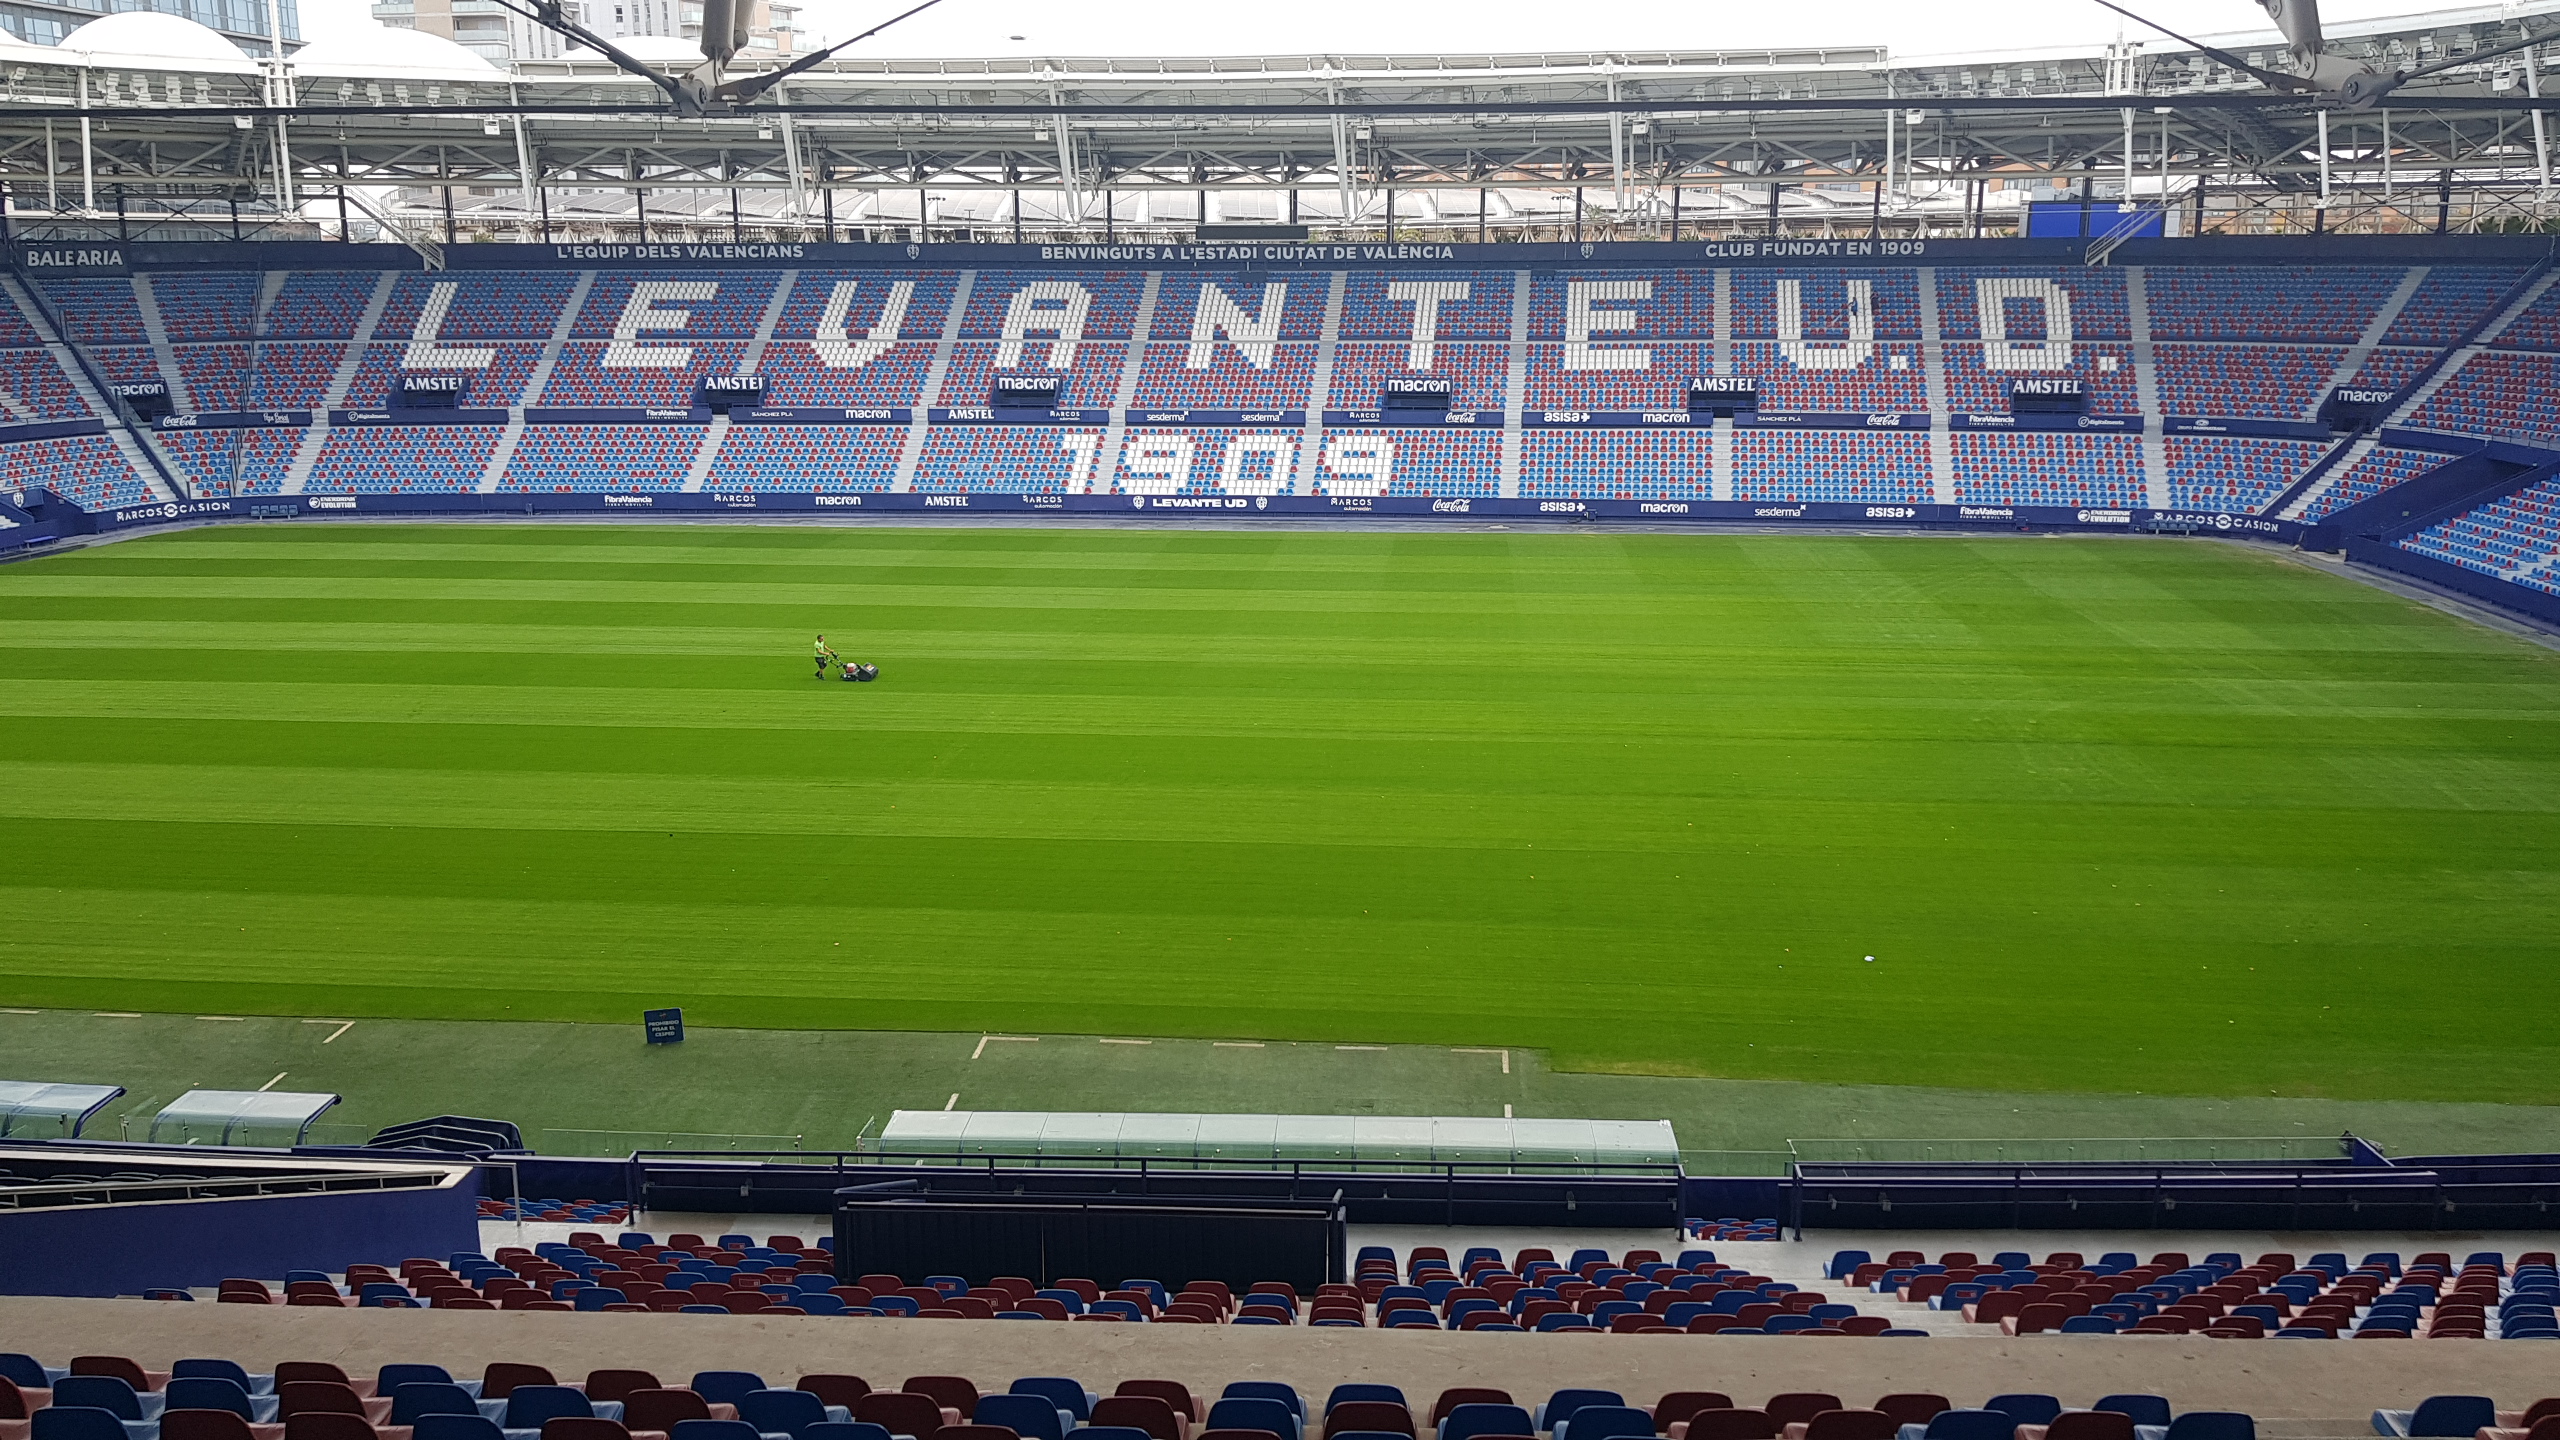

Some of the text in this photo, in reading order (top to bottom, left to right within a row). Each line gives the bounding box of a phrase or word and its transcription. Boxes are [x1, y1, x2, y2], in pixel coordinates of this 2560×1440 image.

[558, 245, 803, 258] L'EQUIP DELS VALENCIANS
[1042, 244, 1454, 260] BENVINGUTS A L'ESTADI CIUTAT DE VALÈNCIA
[1706, 242, 1924, 257] CLUB FUNDAT EN 1909
[1387, 379, 1450, 392] macron
[1690, 377, 1757, 392] AMSTEL
[2012, 379, 2083, 394] AMSTEL
[846, 408, 892, 418] macron
[948, 409, 995, 419] AMSTEL
[1146, 412, 1185, 421] sesderma
[1241, 412, 1280, 421] sesderma
[1543, 412, 1579, 423] asisa
[1642, 413, 1690, 423] macron
[714, 494, 756, 502] MARCOS
[816, 497, 861, 505] macron
[924, 496, 970, 506] AMSTEL
[1153, 499, 1247, 507] LEVANTE UD
[1330, 498, 1373, 506] MARCOS
[1539, 501, 1576, 512] asisa
[1640, 503, 1689, 513] macron
[1754, 506, 1801, 517] sesderma
[116, 508, 162, 522] MARCOS
[1865, 507, 1905, 518] asisa
